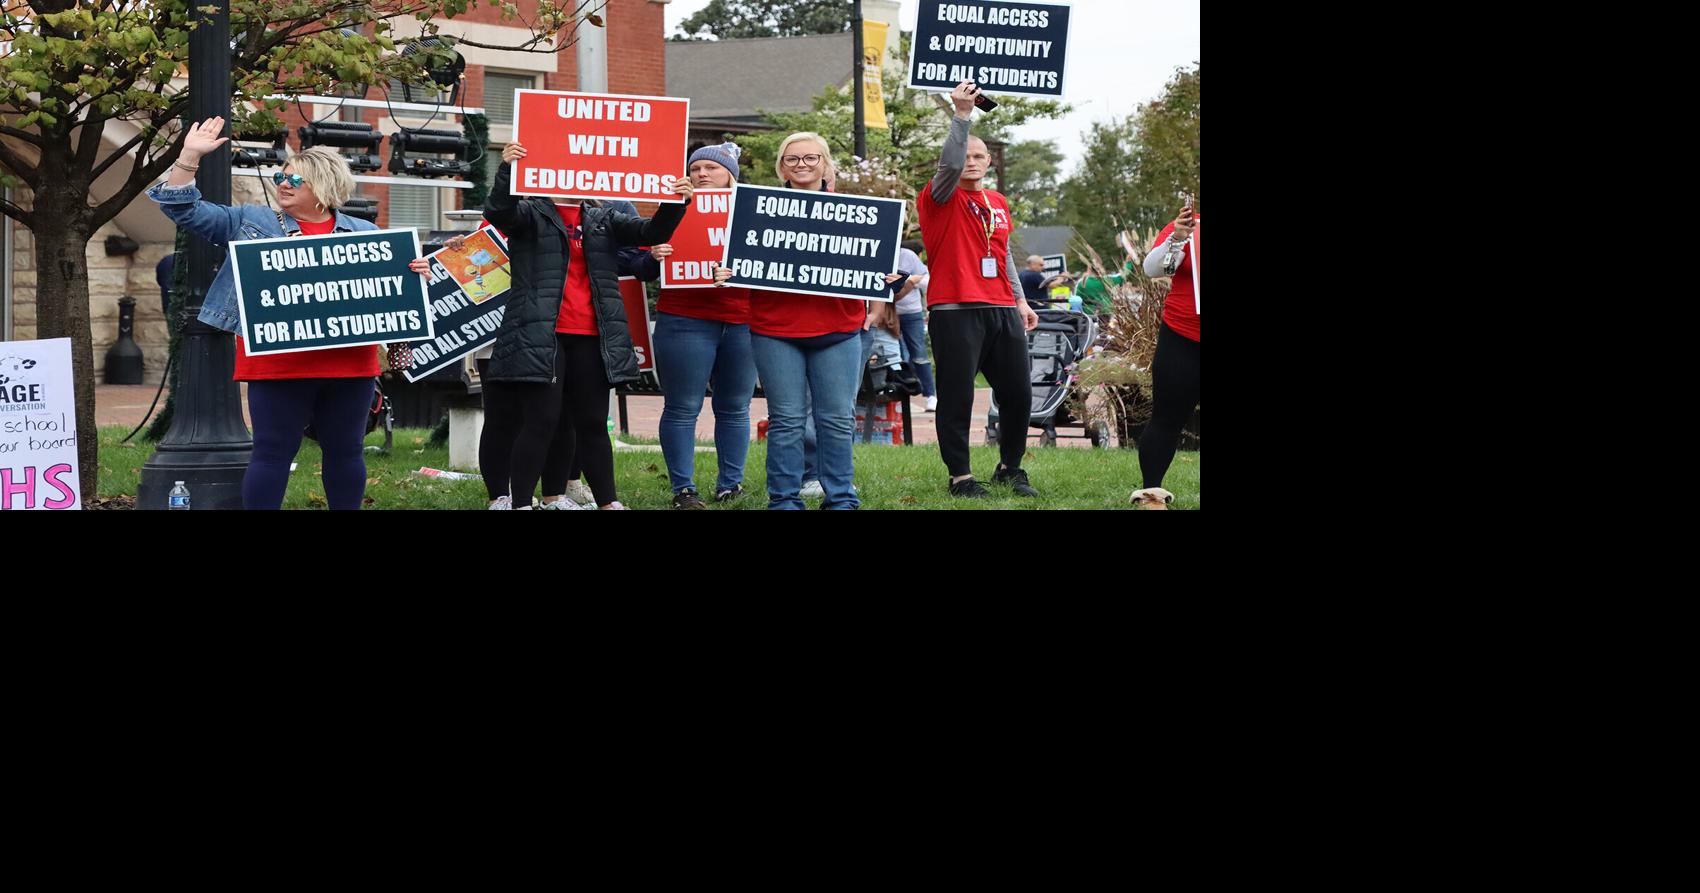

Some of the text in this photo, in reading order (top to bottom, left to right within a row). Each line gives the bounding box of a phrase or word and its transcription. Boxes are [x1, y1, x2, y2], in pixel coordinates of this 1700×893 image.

[938, 4, 1049, 28] EQUAL ACCESS
[929, 34, 1052, 58] & OPPORTUNITY
[917, 62, 1058, 89] FOR ALL STUDENTS
[557, 98, 651, 122] UNITED
[568, 134, 639, 158] WITH
[524, 167, 677, 195] EDUCATORS
[756, 195, 879, 226] EQUAL ACCESS
[260, 241, 393, 272] EQUAL ACCESS
[745, 229, 881, 258] & OPPORTUNITY
[732, 258, 887, 291] FOR ALL STUDENTS
[260, 275, 404, 307] & OPPORTUNITY
[254, 310, 421, 344] FOR ALL STUDENTS
[435, 330, 467, 361] ALL
[460, 305, 506, 341] STUD
[0, 384, 41, 403] AGE
[4, 412, 66, 432] school
[29, 430, 76, 450] board
[0, 463, 76, 509] HS
